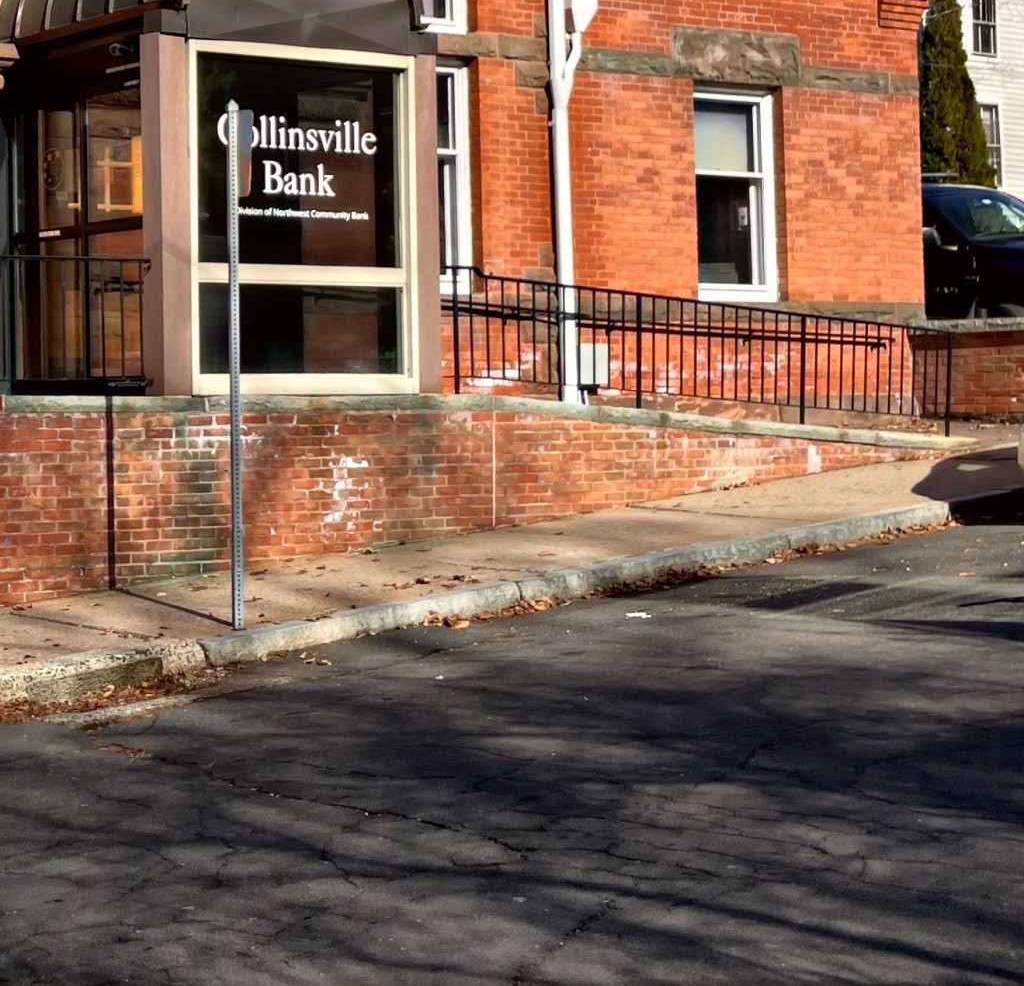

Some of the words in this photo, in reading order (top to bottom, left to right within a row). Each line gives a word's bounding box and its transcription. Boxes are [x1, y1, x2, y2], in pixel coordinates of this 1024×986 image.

[262, 160, 336, 197] Bank
[264, 207, 273, 216] of
[273, 208, 310, 218] Northwest
[311, 210, 351, 221] Community
[351, 212, 369, 220] Bank
